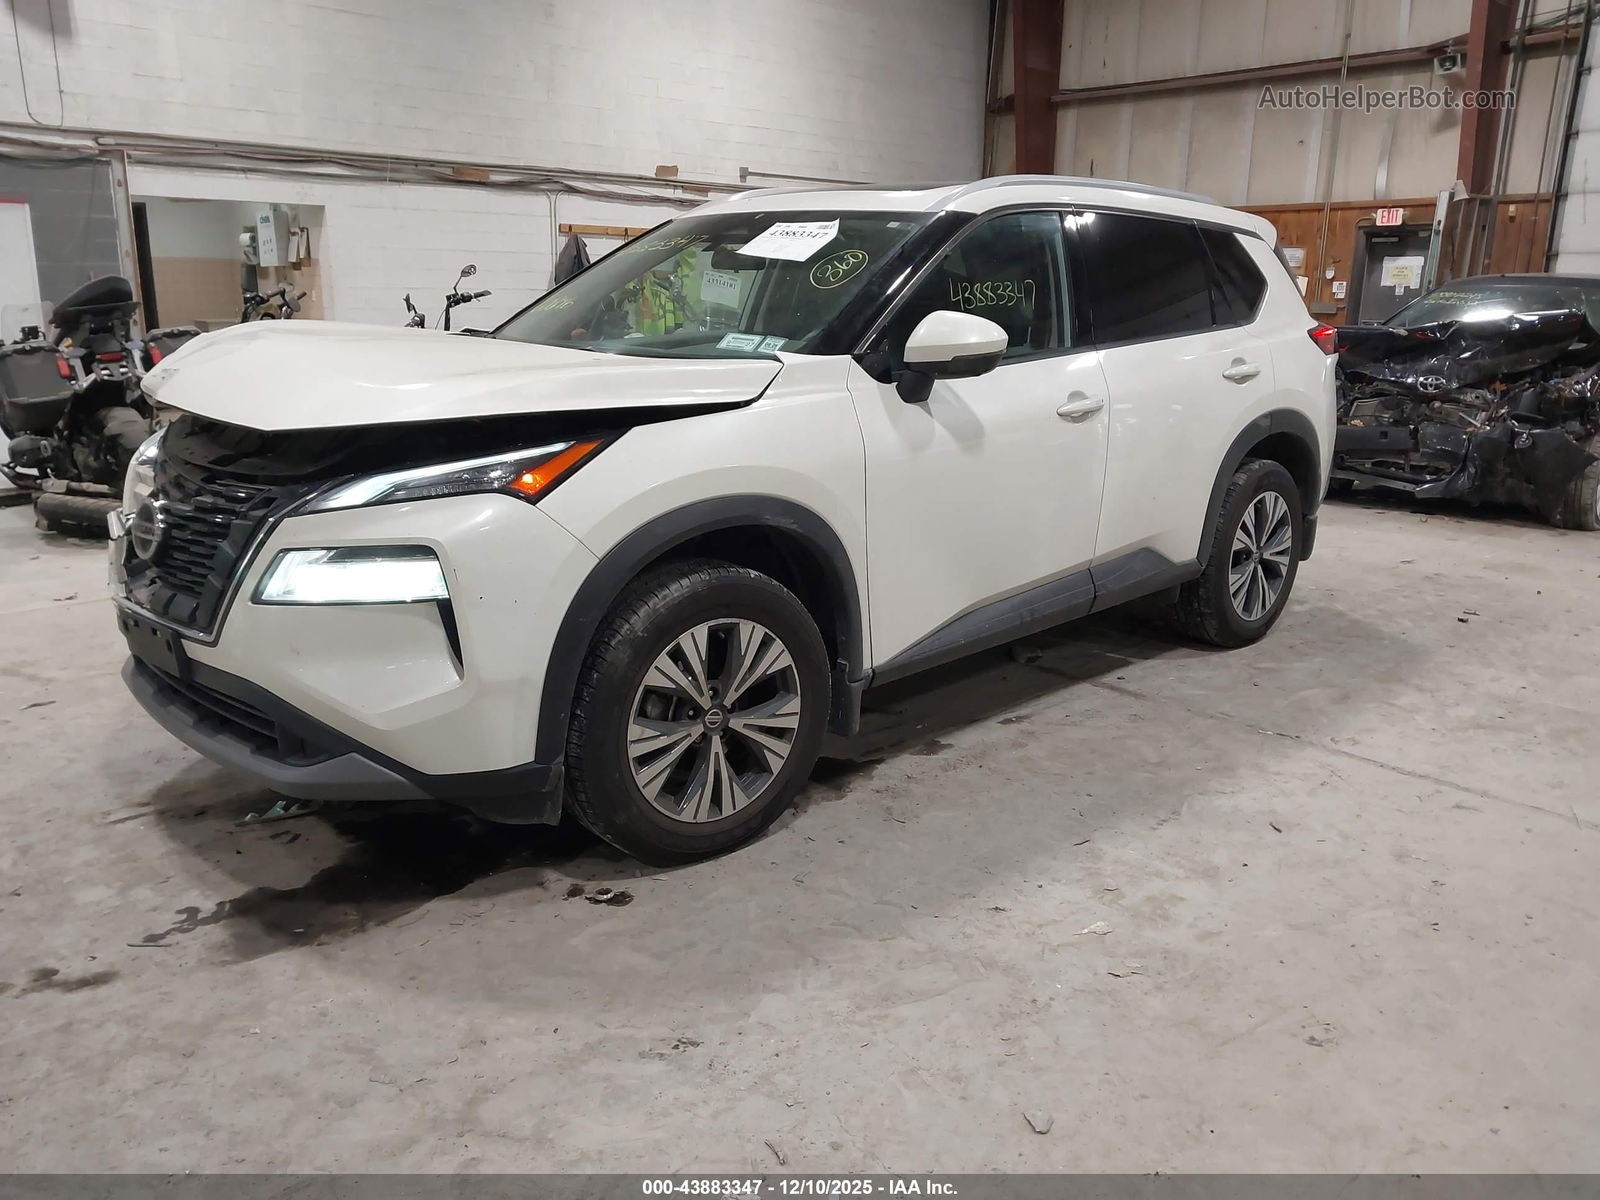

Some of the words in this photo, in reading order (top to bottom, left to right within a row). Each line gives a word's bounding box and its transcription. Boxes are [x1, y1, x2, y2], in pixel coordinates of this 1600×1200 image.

[1380, 209, 1401, 225] EXIT
[816, 251, 863, 282] 360
[948, 277, 1036, 311] 43883347
